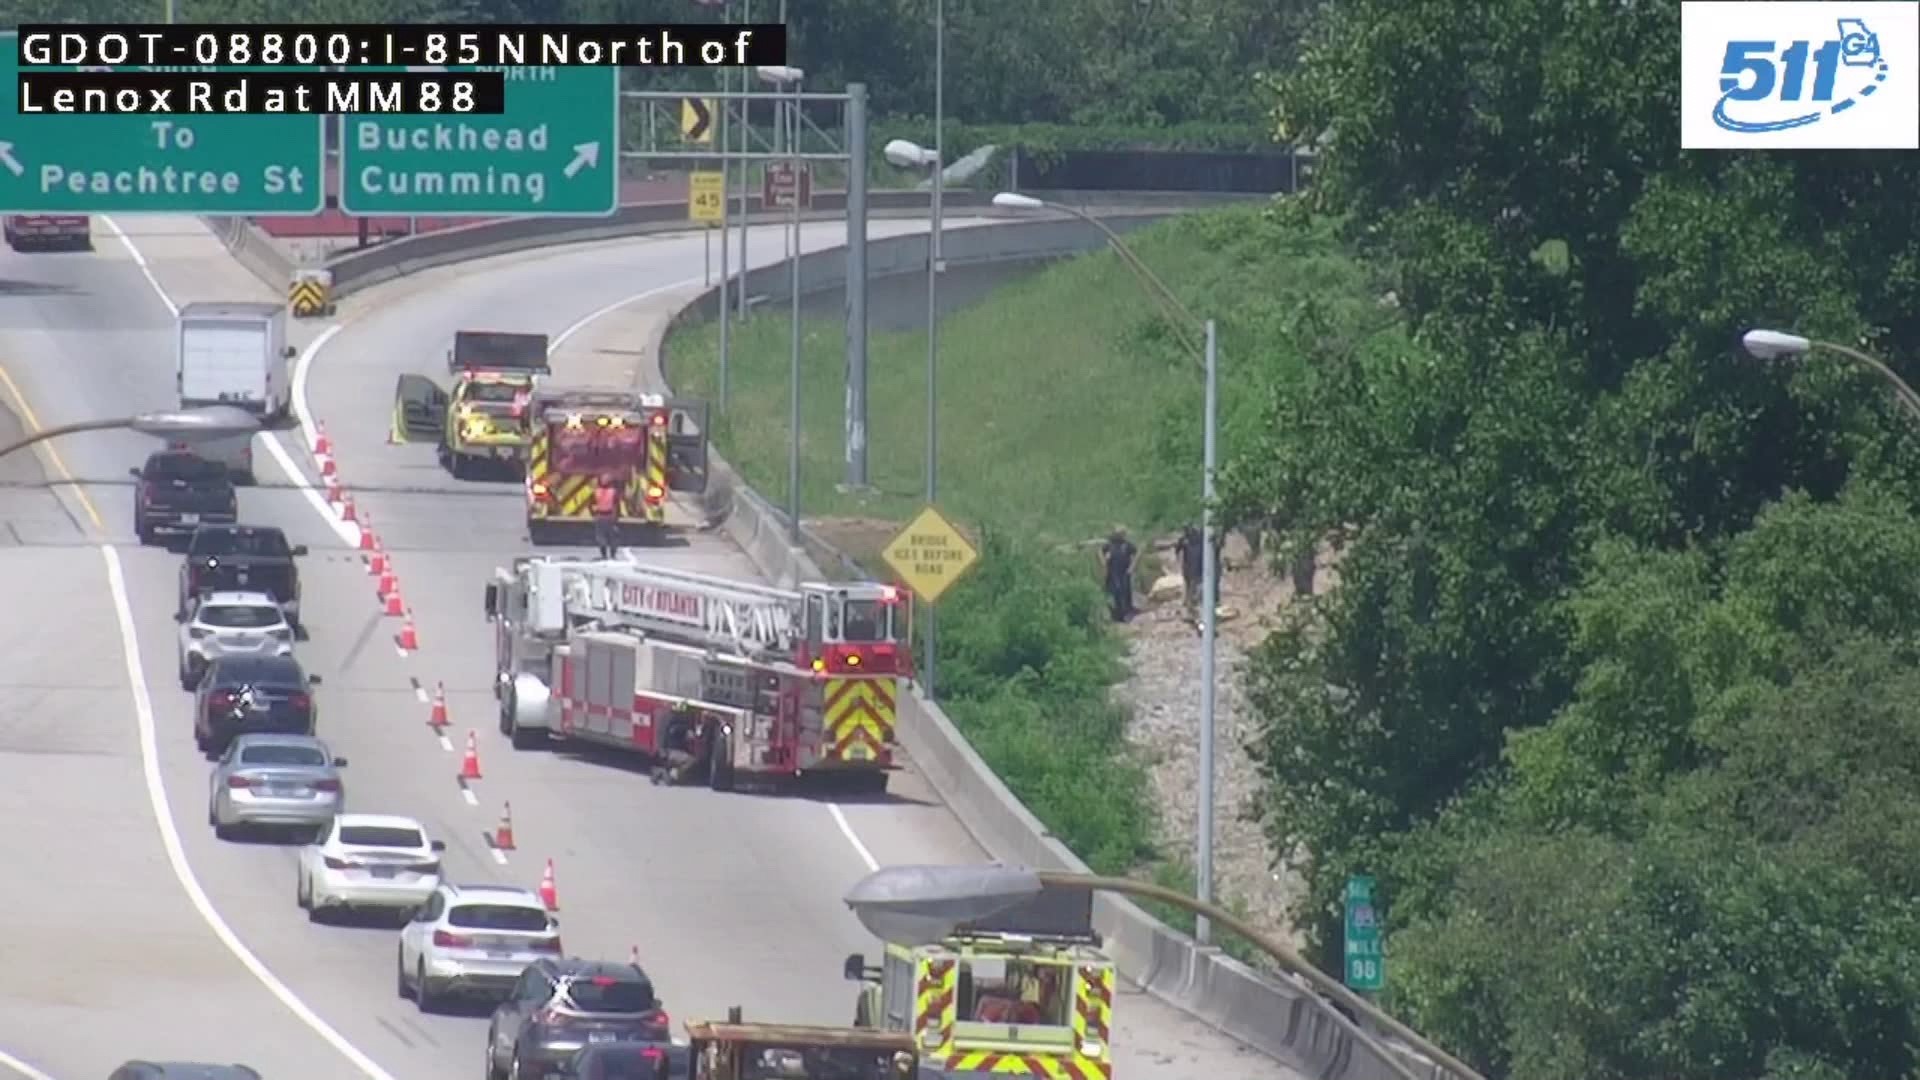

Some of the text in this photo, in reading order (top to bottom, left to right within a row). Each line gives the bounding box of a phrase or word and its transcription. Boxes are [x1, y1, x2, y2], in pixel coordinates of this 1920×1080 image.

[151, 122, 195, 149] To
[357, 123, 548, 151] Buckhead
[40, 164, 304, 193] Peachtree St
[360, 166, 546, 204] Cumming
[695, 193, 720, 207] 45
[622, 583, 644, 609] CITY
[656, 591, 699, 617] ATLANTA
